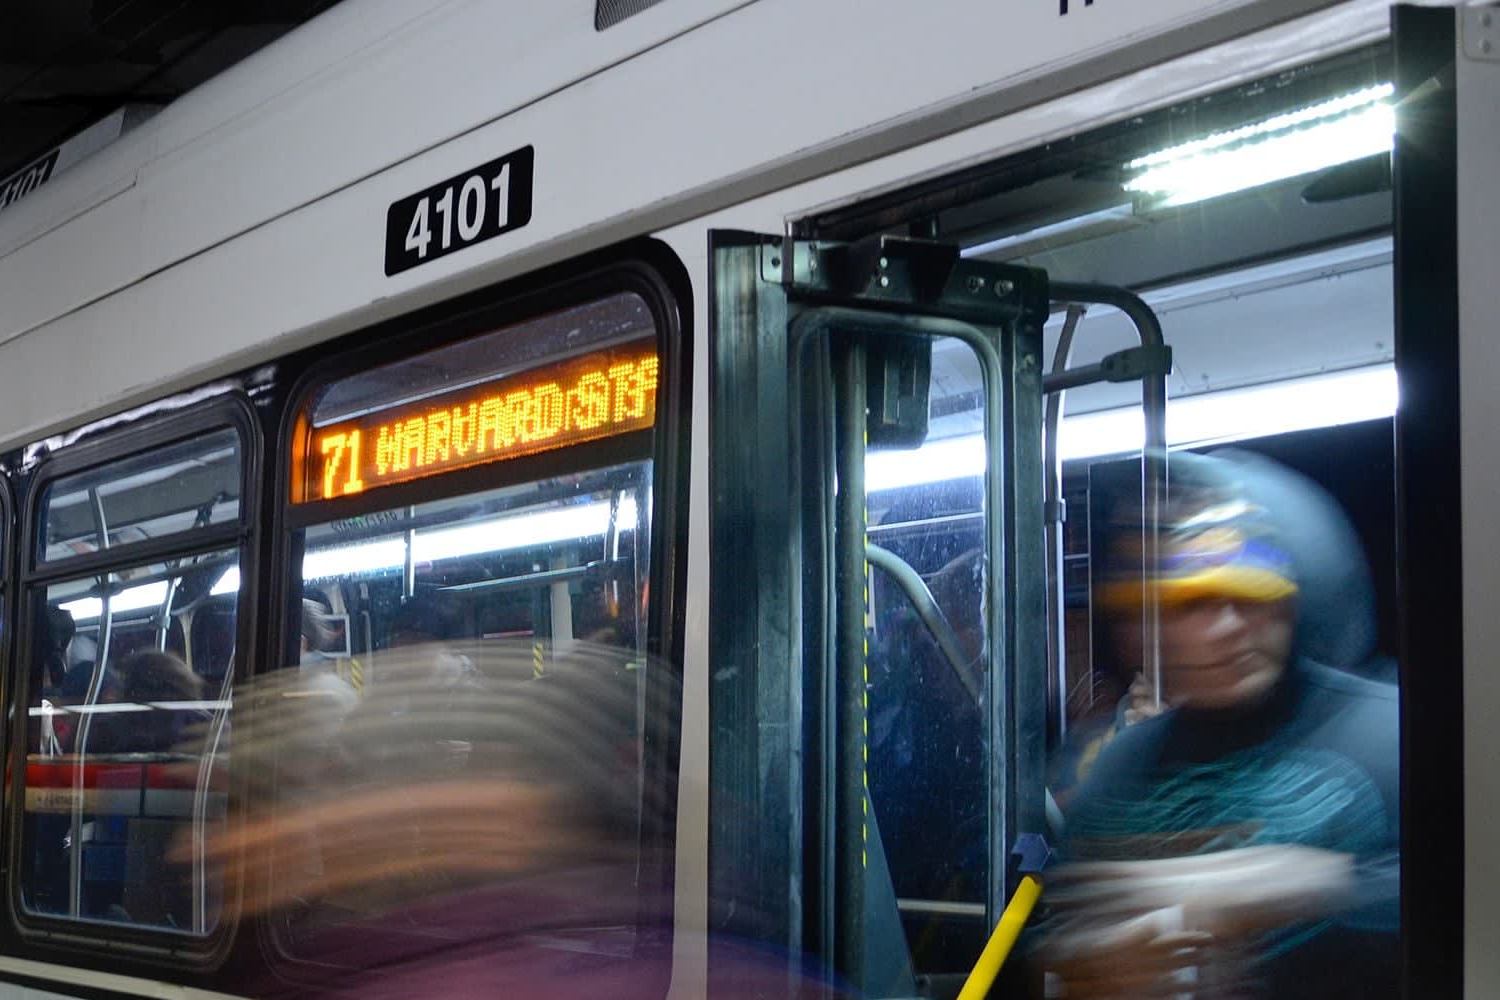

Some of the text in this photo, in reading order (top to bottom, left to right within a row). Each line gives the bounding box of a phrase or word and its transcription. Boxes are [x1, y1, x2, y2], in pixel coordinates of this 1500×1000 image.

[405, 162, 510, 259] 4101
[322, 430, 364, 499] 71
[376, 382, 563, 476] HARVARD
